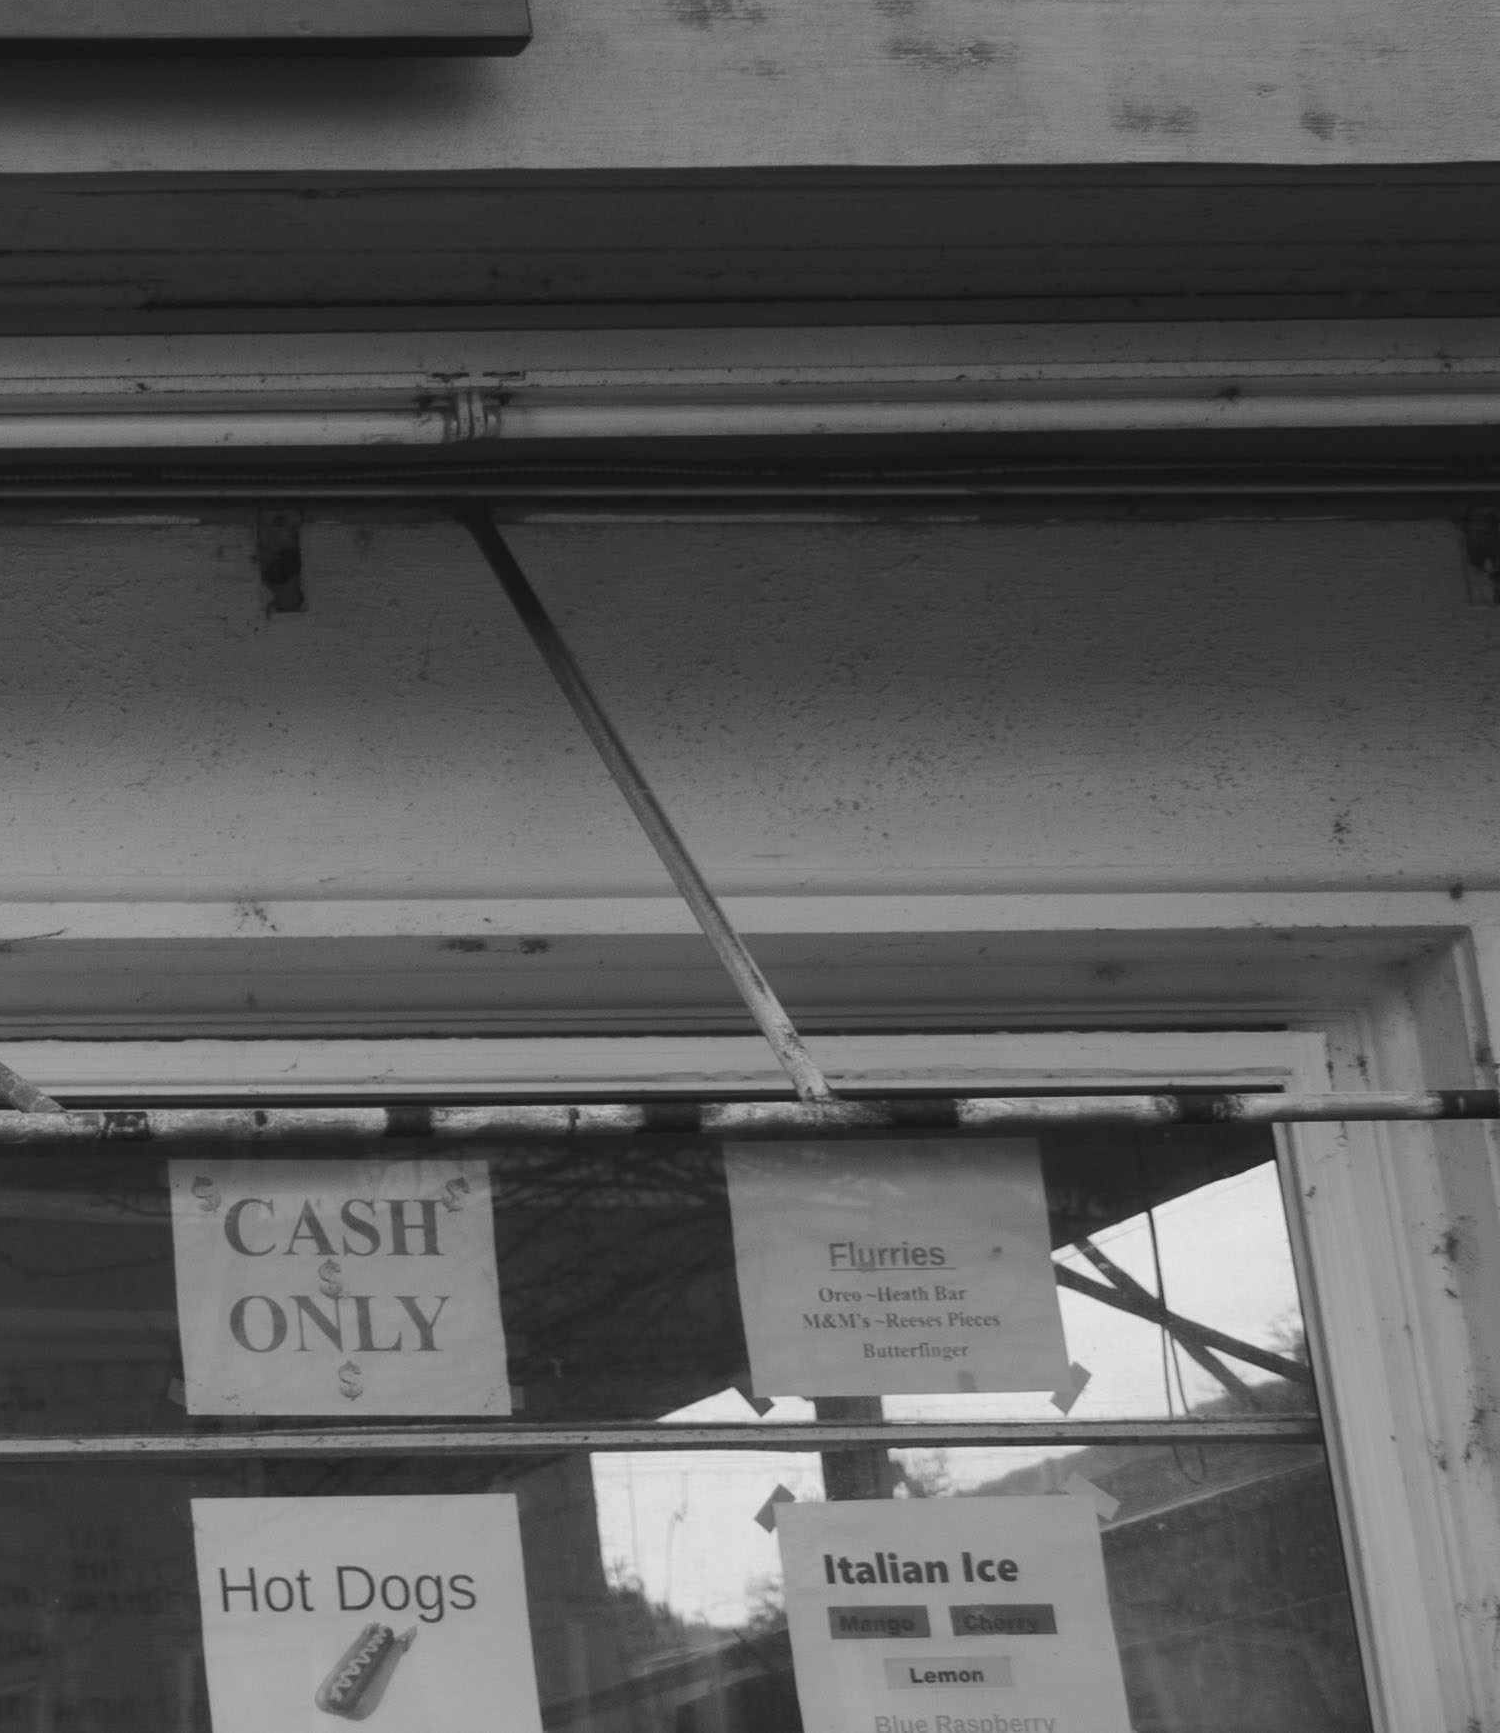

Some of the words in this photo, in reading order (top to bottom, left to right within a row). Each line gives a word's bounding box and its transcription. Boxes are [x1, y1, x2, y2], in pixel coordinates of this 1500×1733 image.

[224, 1198, 447, 1256] CASH
[829, 1241, 946, 1267] Flurries
[818, 1287, 861, 1302] Oreo
[934, 1285, 967, 1301] Bar
[229, 1295, 450, 1353] ONLY
[948, 1311, 1001, 1327] Pieces
[863, 1342, 969, 1361] Butterfinger
[823, 1551, 949, 1584] Italian
[961, 1551, 1019, 1583] Ice
[220, 1565, 314, 1613] Hot
[337, 1564, 477, 1623] Dogs
[839, 1614, 915, 1635] Mango
[963, 1613, 1039, 1634] Cherry
[910, 1667, 985, 1683] Lemon
[875, 1715, 929, 1733] Blue
